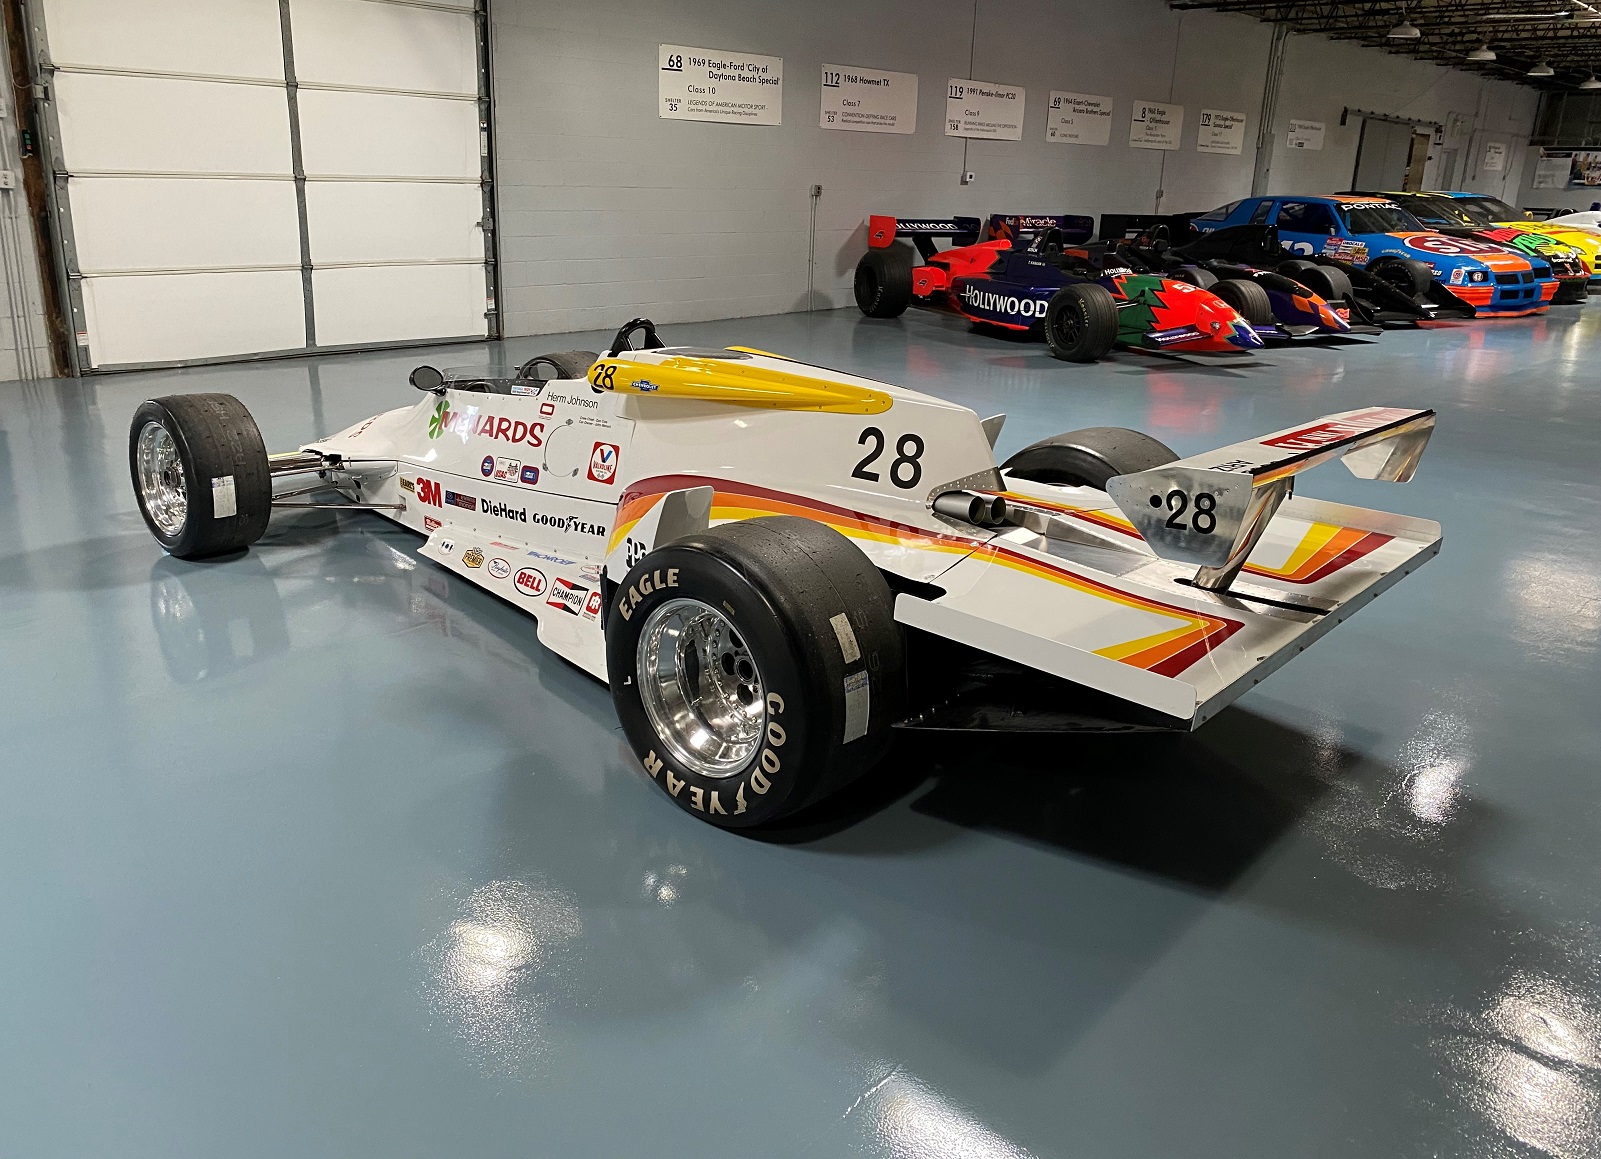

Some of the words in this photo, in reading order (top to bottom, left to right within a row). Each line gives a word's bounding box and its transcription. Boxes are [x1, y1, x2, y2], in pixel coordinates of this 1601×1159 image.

[668, 54, 682, 68] 68
[688, 56, 706, 67] 1969
[708, 60, 745, 71] Eagle-Ford
[762, 65, 768, 74] of
[708, 70, 736, 82] Daytona
[738, 74, 756, 83] Beach
[824, 72, 840, 84] 112
[859, 76, 882, 86] Howmet
[688, 84, 706, 94] Class
[708, 86, 716, 94] 10
[950, 85, 964, 96] 119
[668, 103, 678, 112] 35
[842, 98, 856, 107] Class
[1141, 107, 1146, 118] 8
[960, 285, 1048, 318] HOLLYWOOD
[594, 364, 618, 390] 28
[547, 392, 566, 404] Herm
[567, 395, 598, 409] Johnson
[851, 427, 924, 489] 28
[416, 477, 442, 508] 3M
[480, 498, 527, 523] DieHard
[1166, 489, 1217, 534] 28
[532, 512, 606, 536] GOODYEAR
[516, 572, 542, 592] BELL
[552, 587, 582, 606] CHAMPION
[618, 568, 680, 622] EAGLE
[644, 692, 787, 816] GOODYEAR
